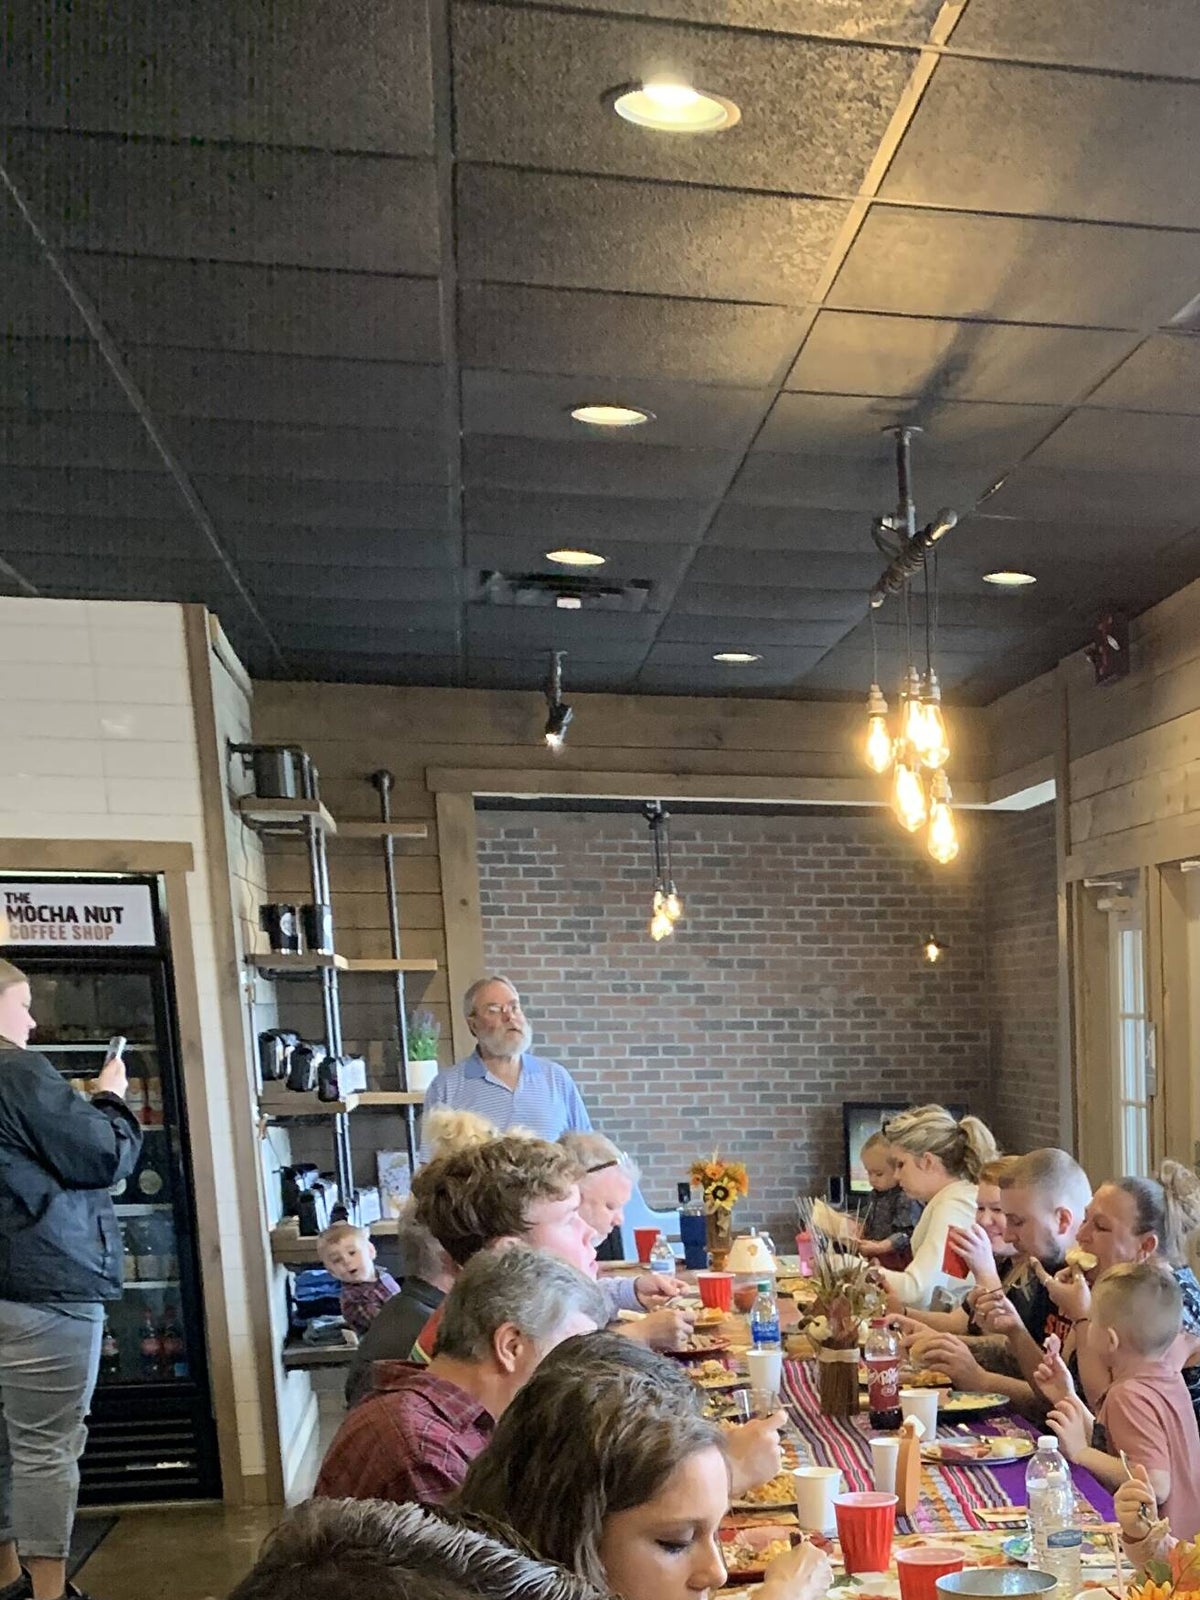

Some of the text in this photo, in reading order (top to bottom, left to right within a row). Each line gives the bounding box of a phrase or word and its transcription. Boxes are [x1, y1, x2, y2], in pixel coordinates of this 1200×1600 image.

[4, 892, 31, 904] THE
[6, 905, 124, 924] MOCHA NUT
[9, 924, 114, 941] COFFEE SHOP
